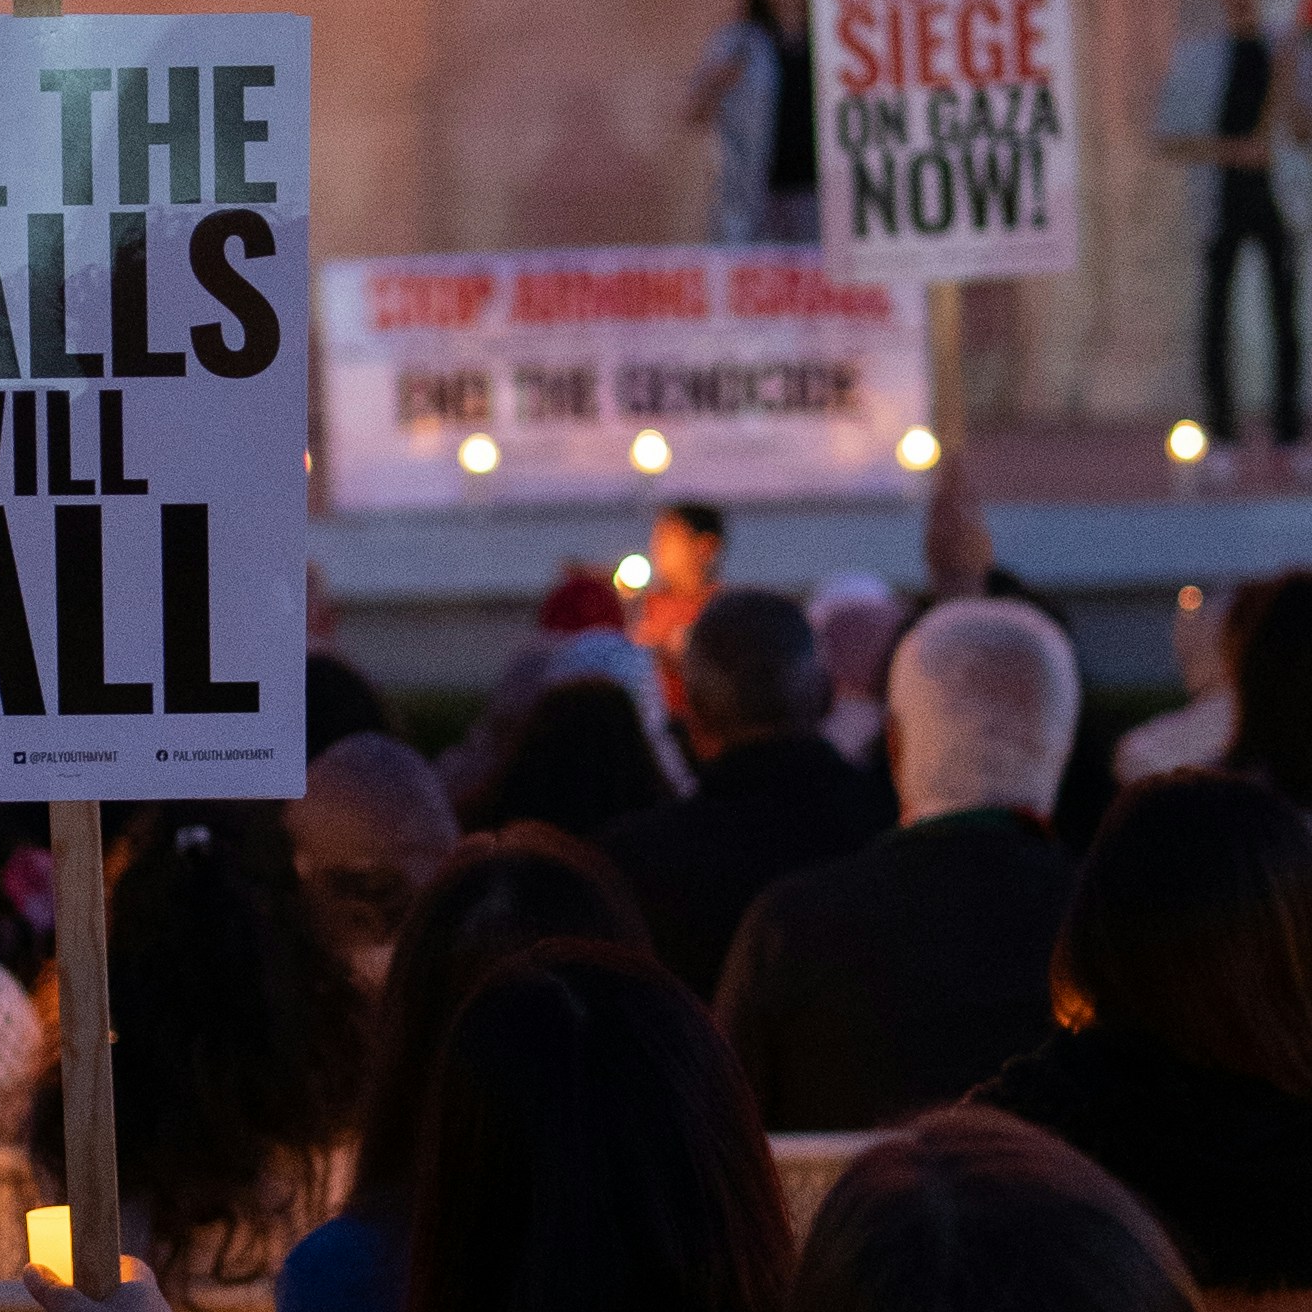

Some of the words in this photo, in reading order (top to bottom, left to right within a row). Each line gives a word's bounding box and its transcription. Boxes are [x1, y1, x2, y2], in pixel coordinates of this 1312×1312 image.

[39, 65, 278, 206] THE
[838, 93, 906, 143] ON
[926, 81, 1061, 140] GAZA
[851, 136, 1046, 237] NOW!
[29, 749, 119, 765] @PALYOUTHMVMT
